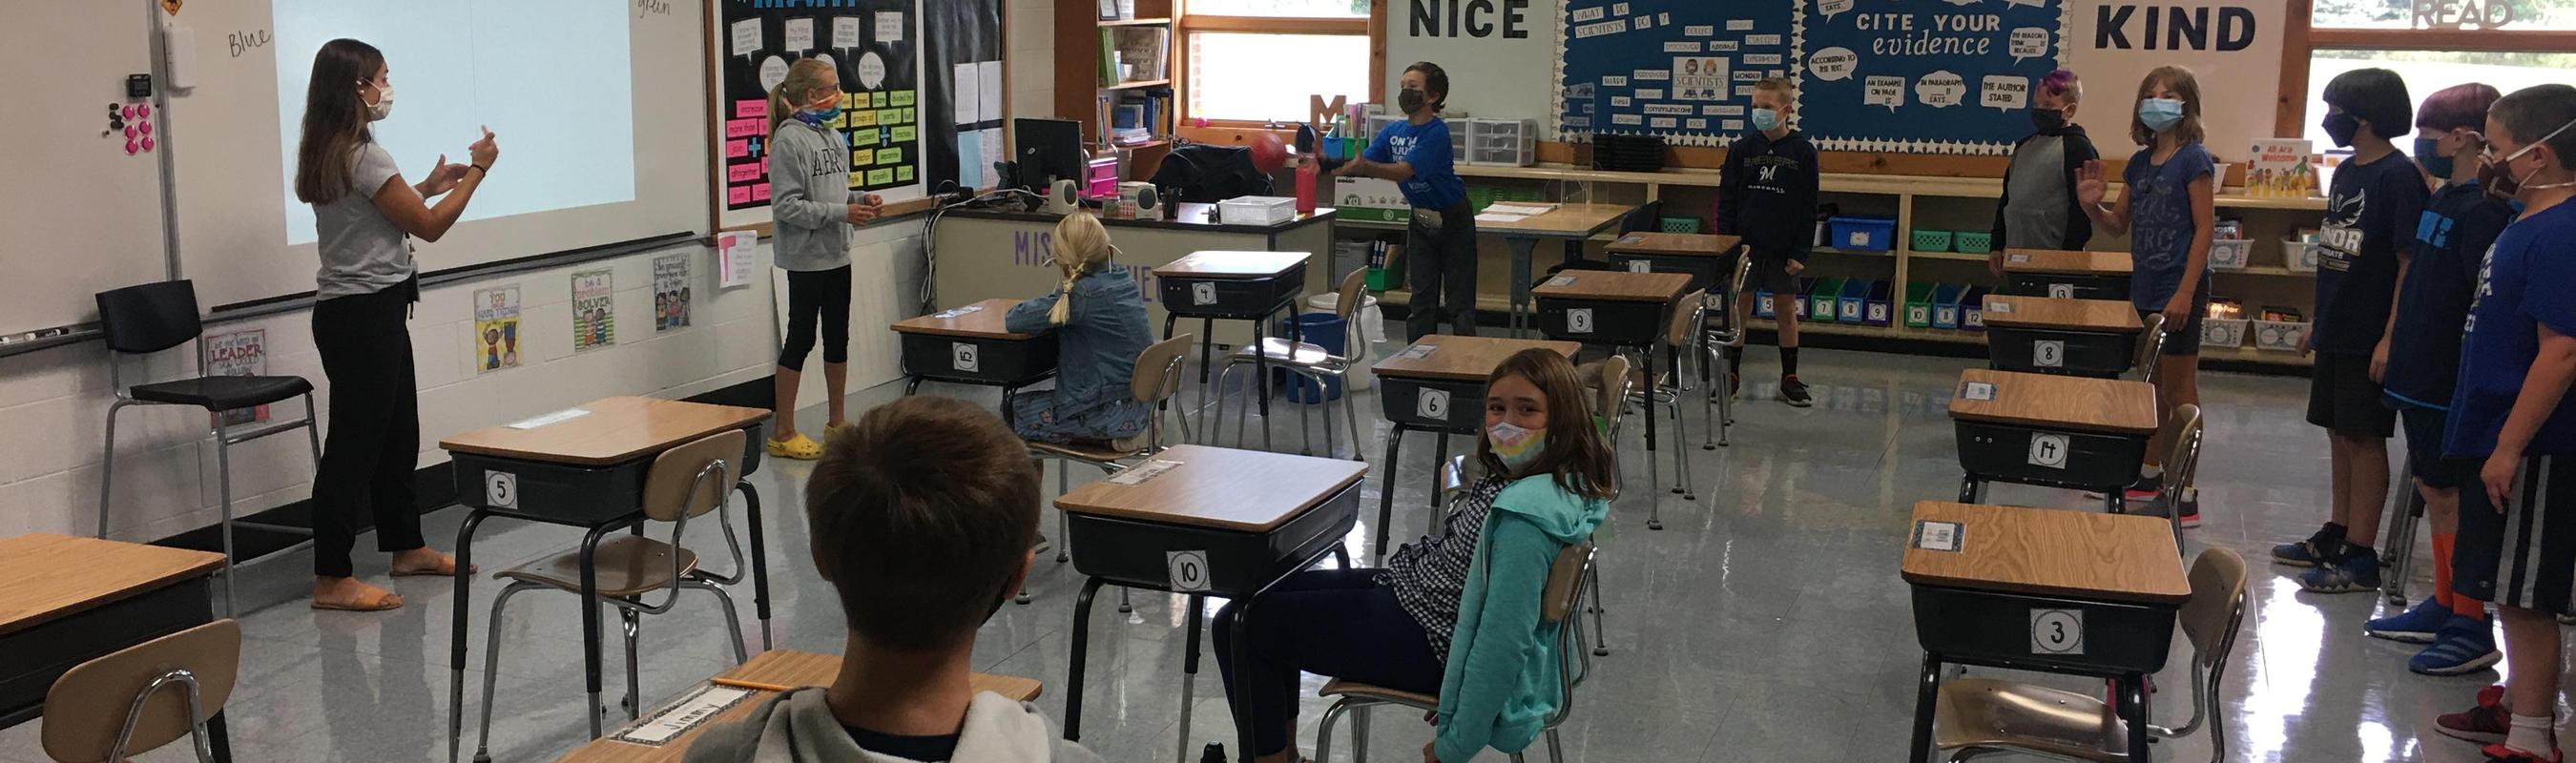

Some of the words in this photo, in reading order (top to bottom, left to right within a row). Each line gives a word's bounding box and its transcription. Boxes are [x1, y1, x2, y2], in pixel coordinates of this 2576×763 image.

[1410, 0, 1528, 38] NICE
[1576, 8, 1600, 20] WHAT
[2412, 0, 2513, 28] READ
[1577, 22, 1624, 37] SCIENTISTS
[1856, 13, 1914, 31] CITE
[1933, 14, 2001, 31] YOUR
[2095, 5, 2255, 52] KIND
[229, 30, 271, 58] Blue
[1872, 29, 1990, 55] evidence
[1811, 55, 1846, 65] ACCORDING
[1675, 76, 1725, 87] SCIENTISTS
[1735, 72, 1760, 80] WONDER
[1984, 81, 1995, 91] THE
[1997, 82, 2026, 92] AUTHOR
[1310, 94, 1346, 134] M
[1743, 155, 1800, 171] BREWERS
[1759, 164, 1777, 181] M
[489, 292, 506, 304] YOU
[1200, 288, 1208, 299] 4
[577, 296, 611, 311] SOLVER
[1766, 300, 1772, 309] 5
[1821, 303, 1827, 312] 7
[1848, 305, 1853, 314] 8
[1875, 308, 1880, 317] 9
[1914, 310, 1922, 320] 10
[1943, 311, 1948, 320] 11
[1971, 313, 1979, 322] 12
[1576, 315, 1584, 327] 9
[212, 343, 260, 361] LEADER
[959, 350, 973, 363] 15
[2045, 346, 2053, 361] 8
[1428, 397, 1438, 412] 6
[2040, 441, 2057, 459] 14
[496, 480, 507, 499] 5
[1180, 561, 1198, 583] 10
[2050, 621, 2065, 644] 3
[664, 703, 719, 731] Jimmy
